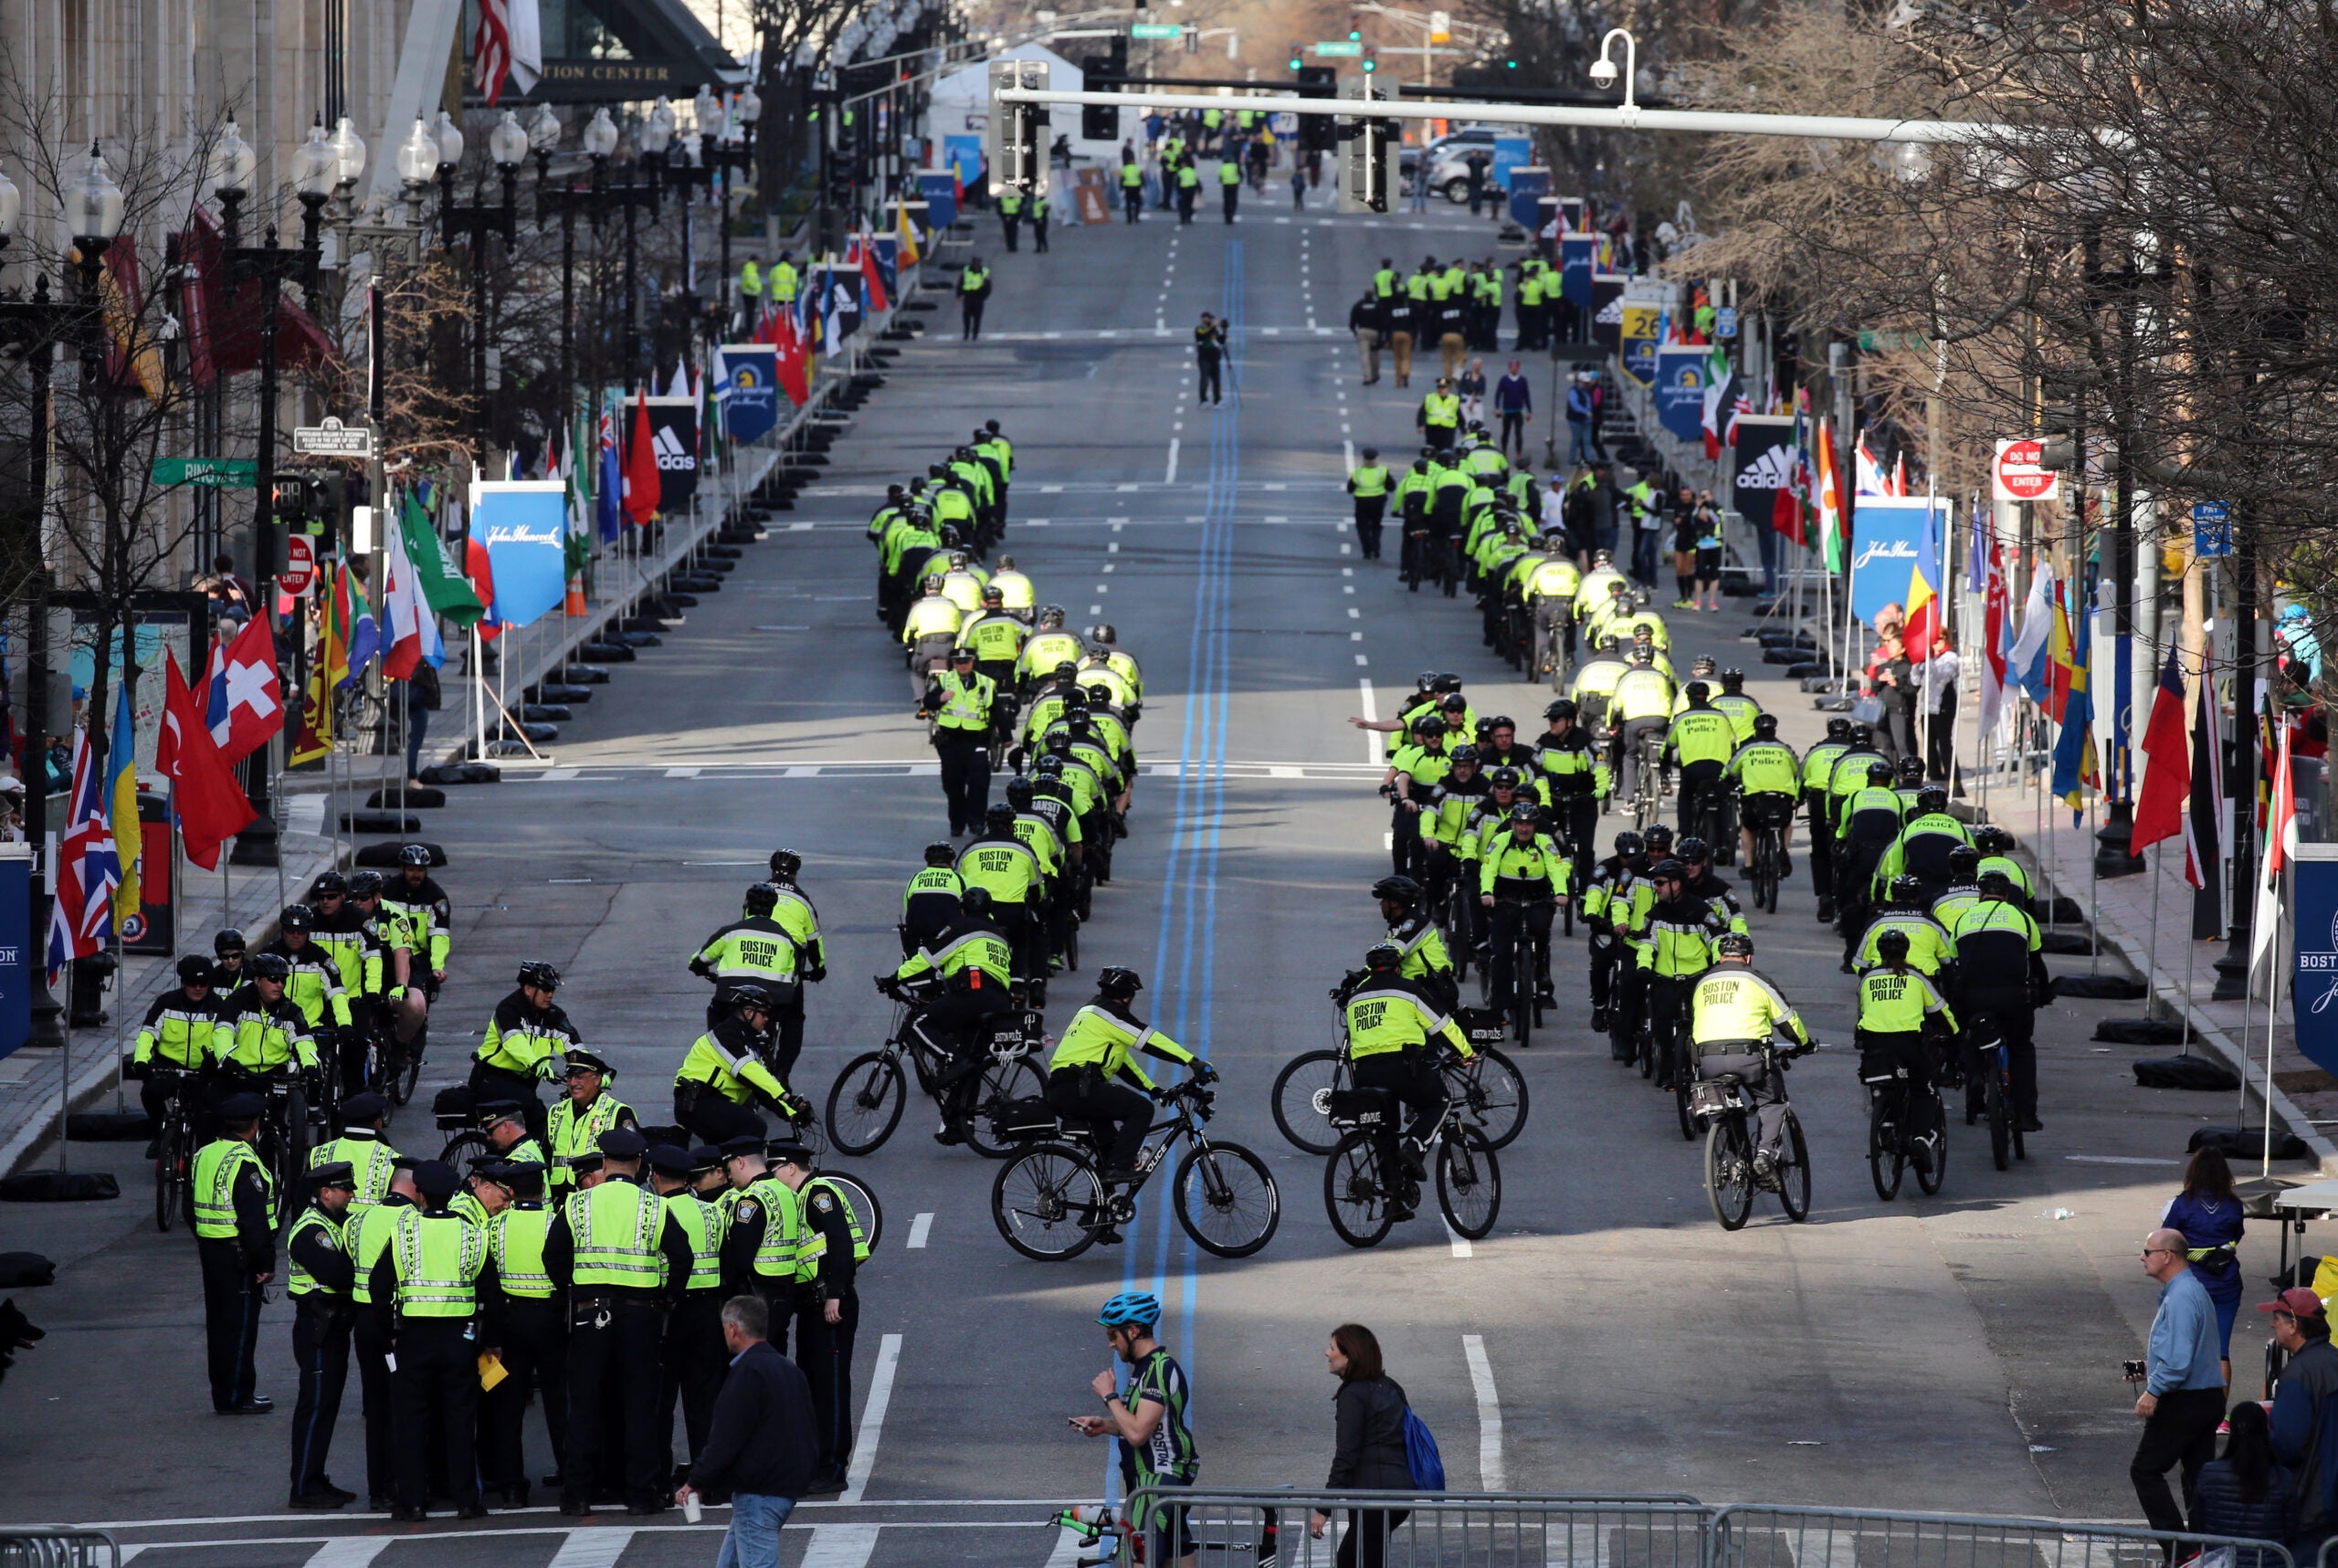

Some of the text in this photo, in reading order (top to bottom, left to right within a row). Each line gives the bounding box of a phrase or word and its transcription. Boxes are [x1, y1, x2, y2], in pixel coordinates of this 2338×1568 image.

[593, 66, 669, 80] CENTER
[1596, 313, 1623, 324] adid
[2010, 452, 2040, 462] DO NO
[185, 464, 215, 483] RING
[1736, 473, 1781, 489] adid
[2012, 477, 2042, 488] ENTER
[292, 548, 306, 558] NOT
[282, 574, 305, 584] ENTER
[1750, 757, 1783, 766] Police
[1014, 823, 1035, 835] STON
[1915, 820, 1954, 829] POLICE
[979, 850, 1013, 862] BOSTON
[981, 861, 1008, 873] POLICE
[918, 877, 949, 888] POLICE
[1970, 916, 2008, 925] POLICE
[740, 941, 777, 955] BOSTON
[742, 952, 774, 968] POLICE
[988, 952, 1008, 967] POLICE
[1703, 981, 1740, 995] BOSTON
[1869, 977, 1907, 990] BOSTON
[1704, 993, 1734, 1006] POLICE
[1871, 988, 1903, 1001] POLICE
[1353, 1001, 1387, 1019] BOSTON
[1355, 1016, 1383, 1032] POLICE
[1472, 1028, 1487, 1039] BOSTON
[320, 1147, 328, 1165] BOS
[371, 1151, 385, 1194] POLICE
